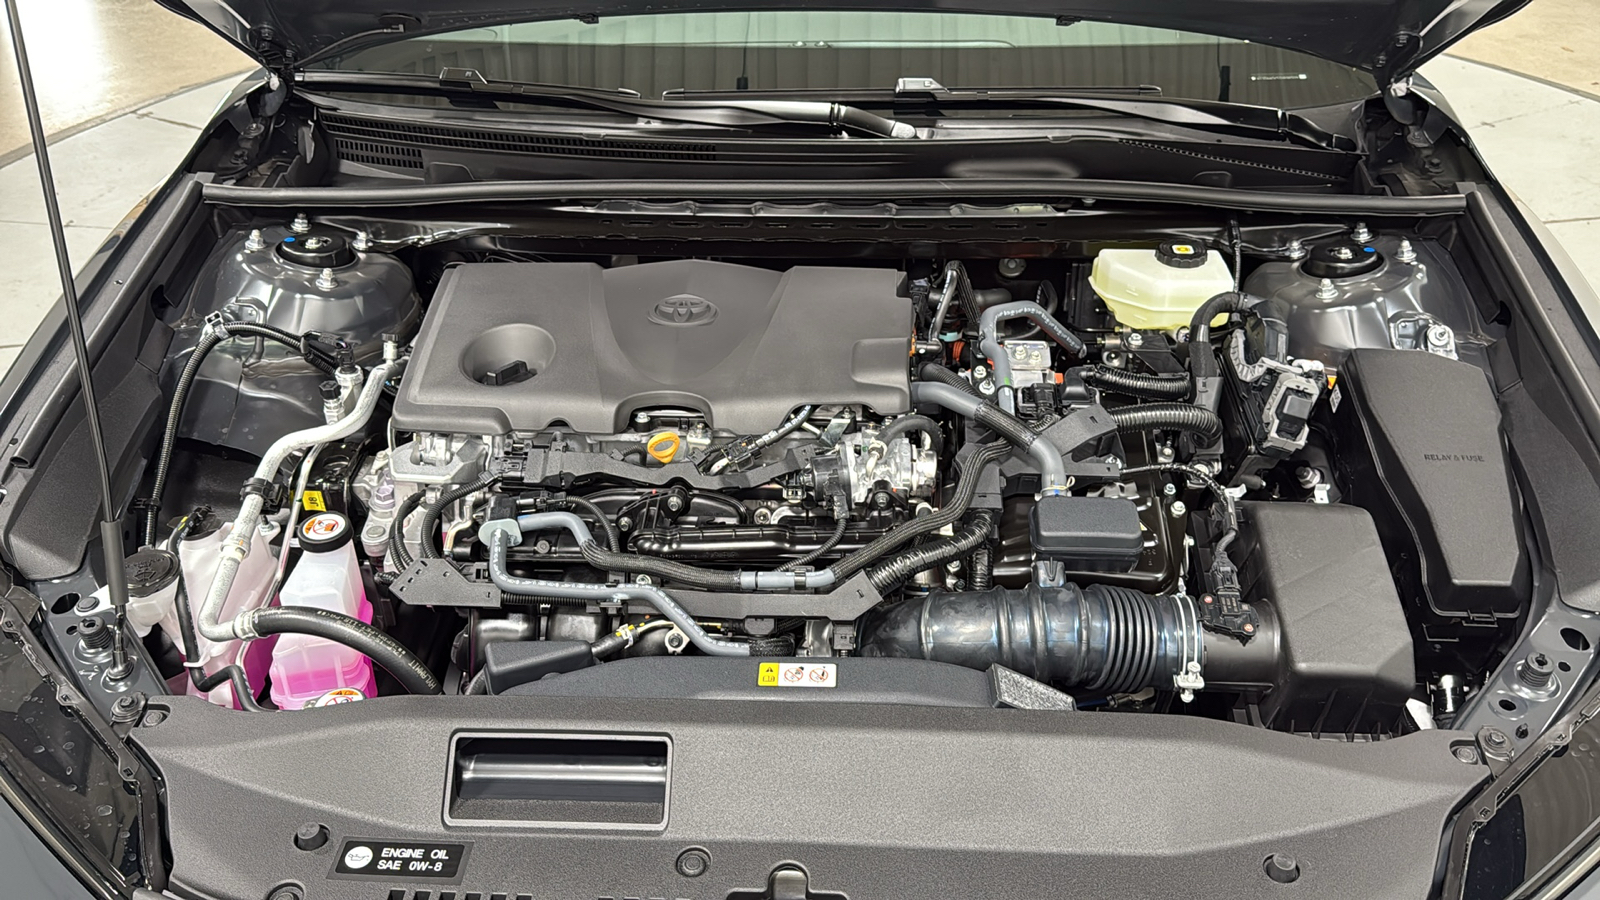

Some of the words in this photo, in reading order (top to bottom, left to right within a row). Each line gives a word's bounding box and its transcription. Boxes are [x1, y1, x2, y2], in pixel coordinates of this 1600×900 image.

[1423, 453, 1452, 461] RELAY
[1461, 454, 1484, 462] FUSE
[381, 848, 425, 859] ENGINE
[430, 849, 449, 860] OIL
[377, 860, 402, 870] SAE
[408, 861, 443, 872] 0W-8
